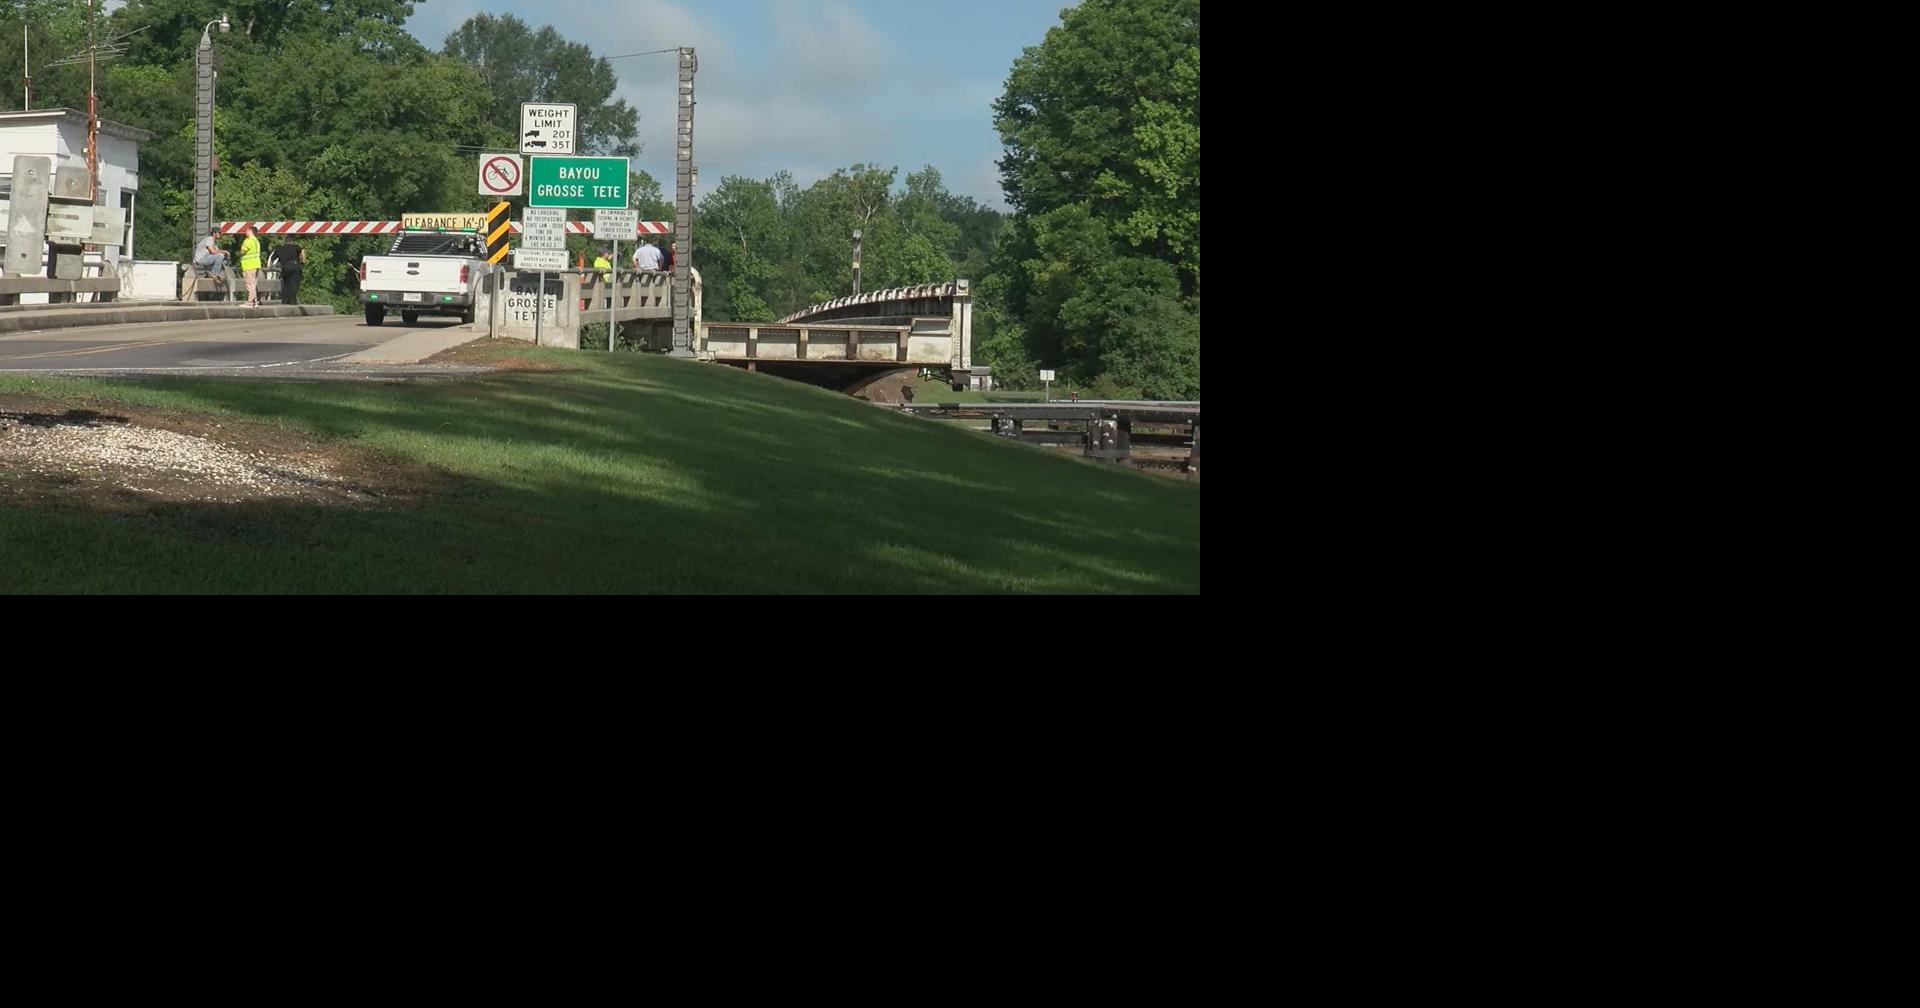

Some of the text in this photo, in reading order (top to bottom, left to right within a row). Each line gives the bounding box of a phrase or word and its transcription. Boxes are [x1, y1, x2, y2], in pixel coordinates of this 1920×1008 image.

[529, 110, 569, 118] WEIGHT
[560, 167, 600, 179] BAYOU
[537, 185, 620, 198] GROSSE TETE
[404, 217, 457, 228] CLEARANCE
